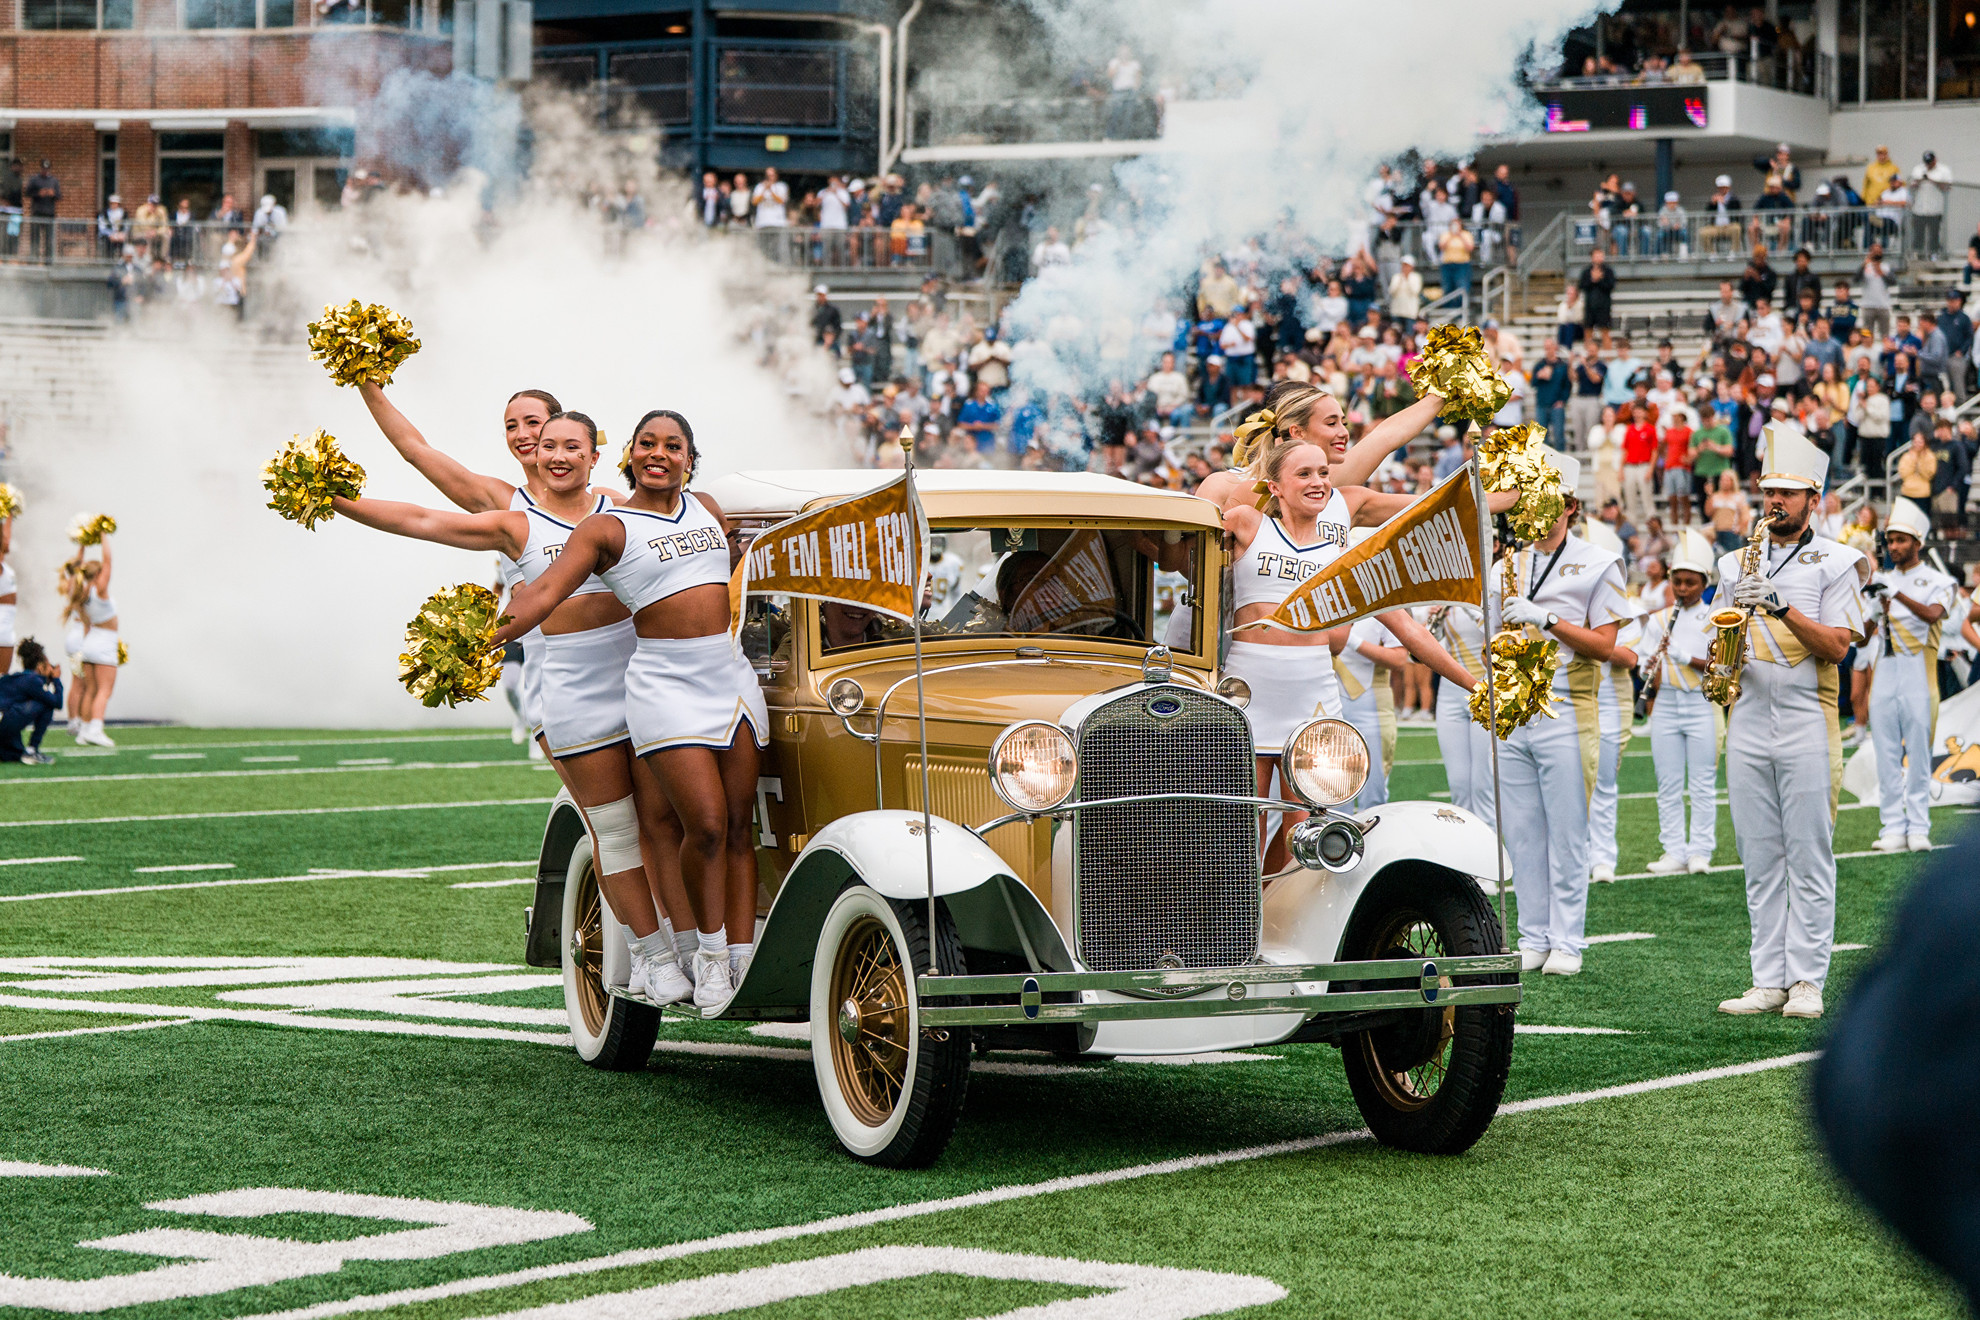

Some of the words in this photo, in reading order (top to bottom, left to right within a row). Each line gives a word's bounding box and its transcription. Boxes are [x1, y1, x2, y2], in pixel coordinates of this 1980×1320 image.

[648, 527, 726, 563] TECH
[748, 543, 776, 581] IVE
[782, 531, 821, 577] 'EM
[828, 521, 871, 580] HELL
[875, 512, 911, 586] TECH
[1317, 520, 1347, 548] CH
[1257, 551, 1322, 582] TEC
[1287, 596, 1311, 628] TO
[1310, 575, 1357, 624] HELL
[1350, 548, 1403, 606] WITH
[1398, 506, 1474, 585] GEORGIA
